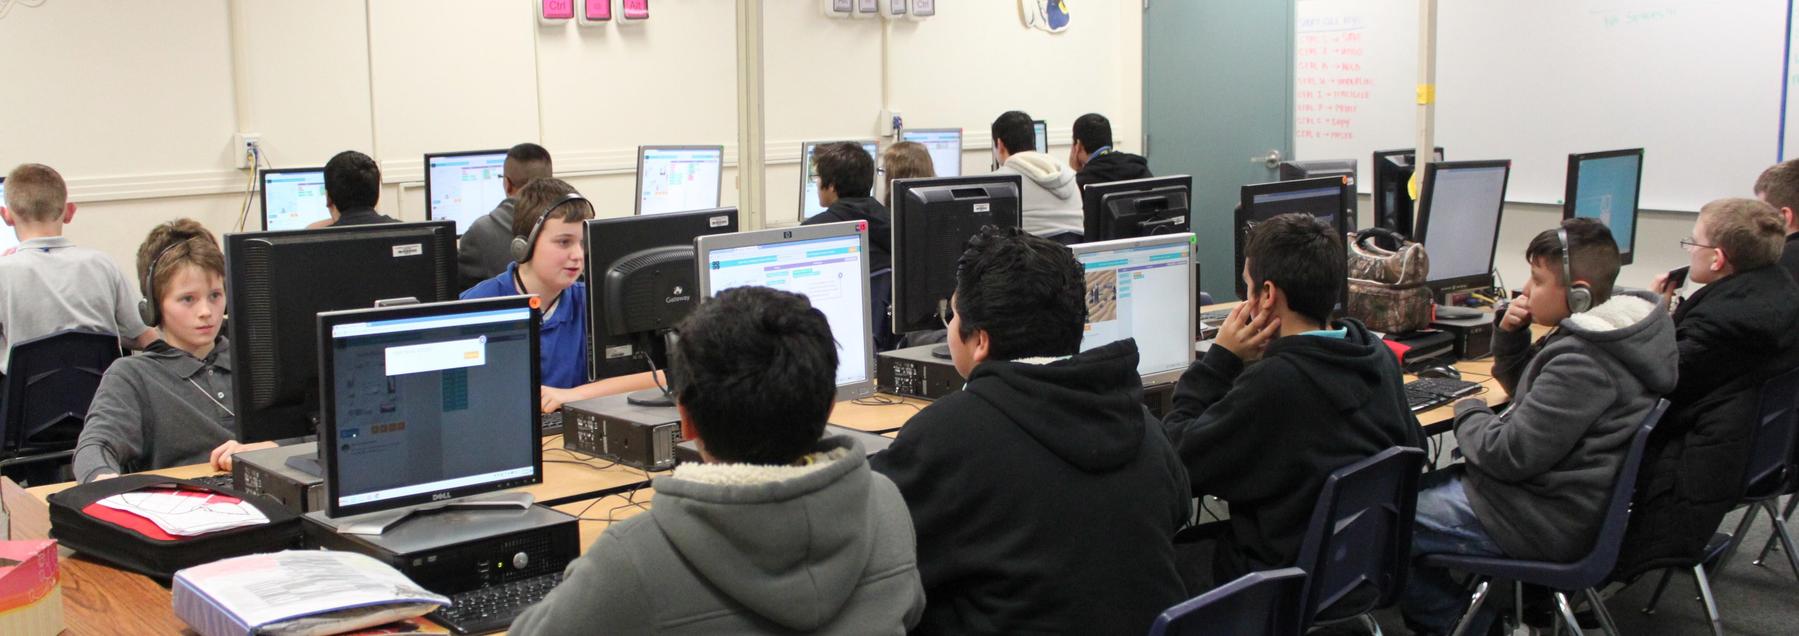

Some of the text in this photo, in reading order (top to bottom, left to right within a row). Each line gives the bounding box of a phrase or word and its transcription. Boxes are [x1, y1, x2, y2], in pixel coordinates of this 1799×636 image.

[548, 1, 566, 10] Ctrl
[665, 295, 690, 303] Gateway
[432, 491, 452, 501] DELL
